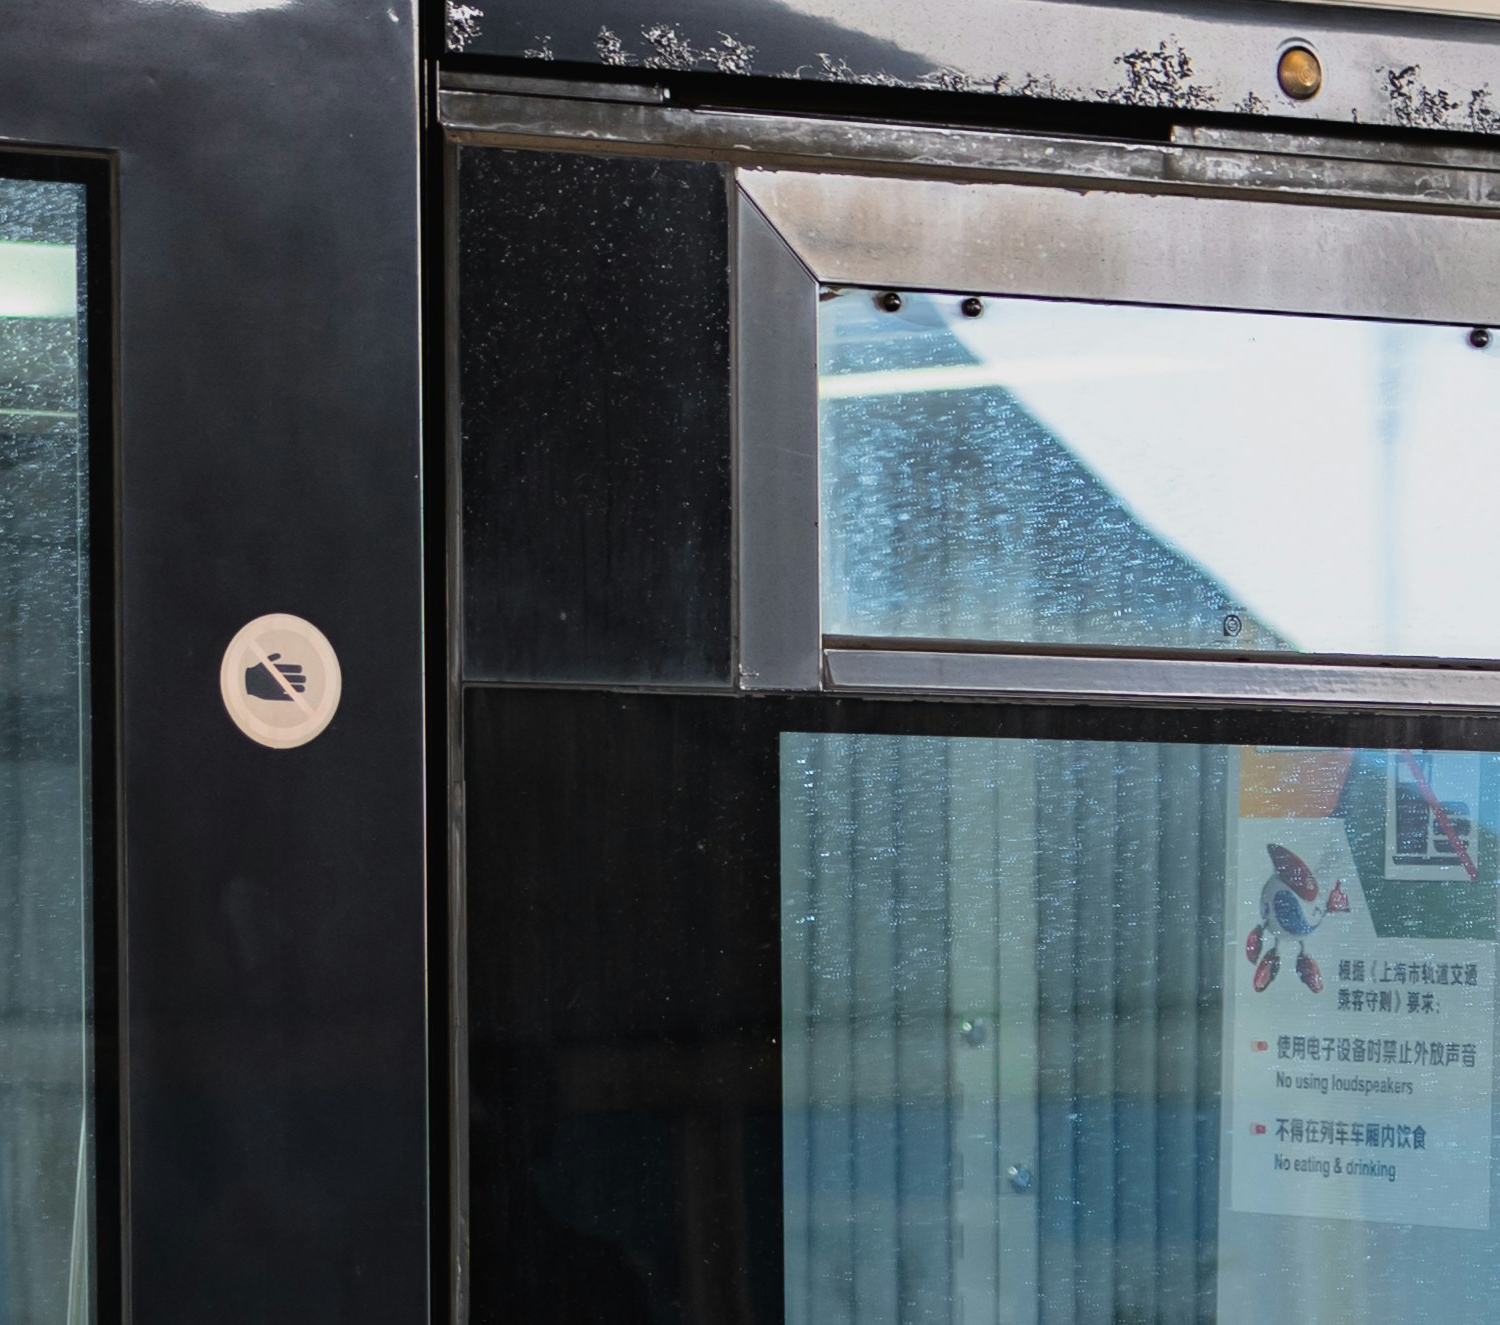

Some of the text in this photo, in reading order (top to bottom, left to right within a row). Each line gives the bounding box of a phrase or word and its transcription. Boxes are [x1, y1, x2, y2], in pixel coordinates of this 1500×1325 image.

[1276, 1035, 1477, 1068] 使用电子设备时禁止外放声音
[1276, 1071, 1414, 1096] No using loudspeakers
[1275, 1118, 1427, 1150] 不得在列车车厢内饮食
[1274, 1154, 1396, 1182] No eating & drinking
